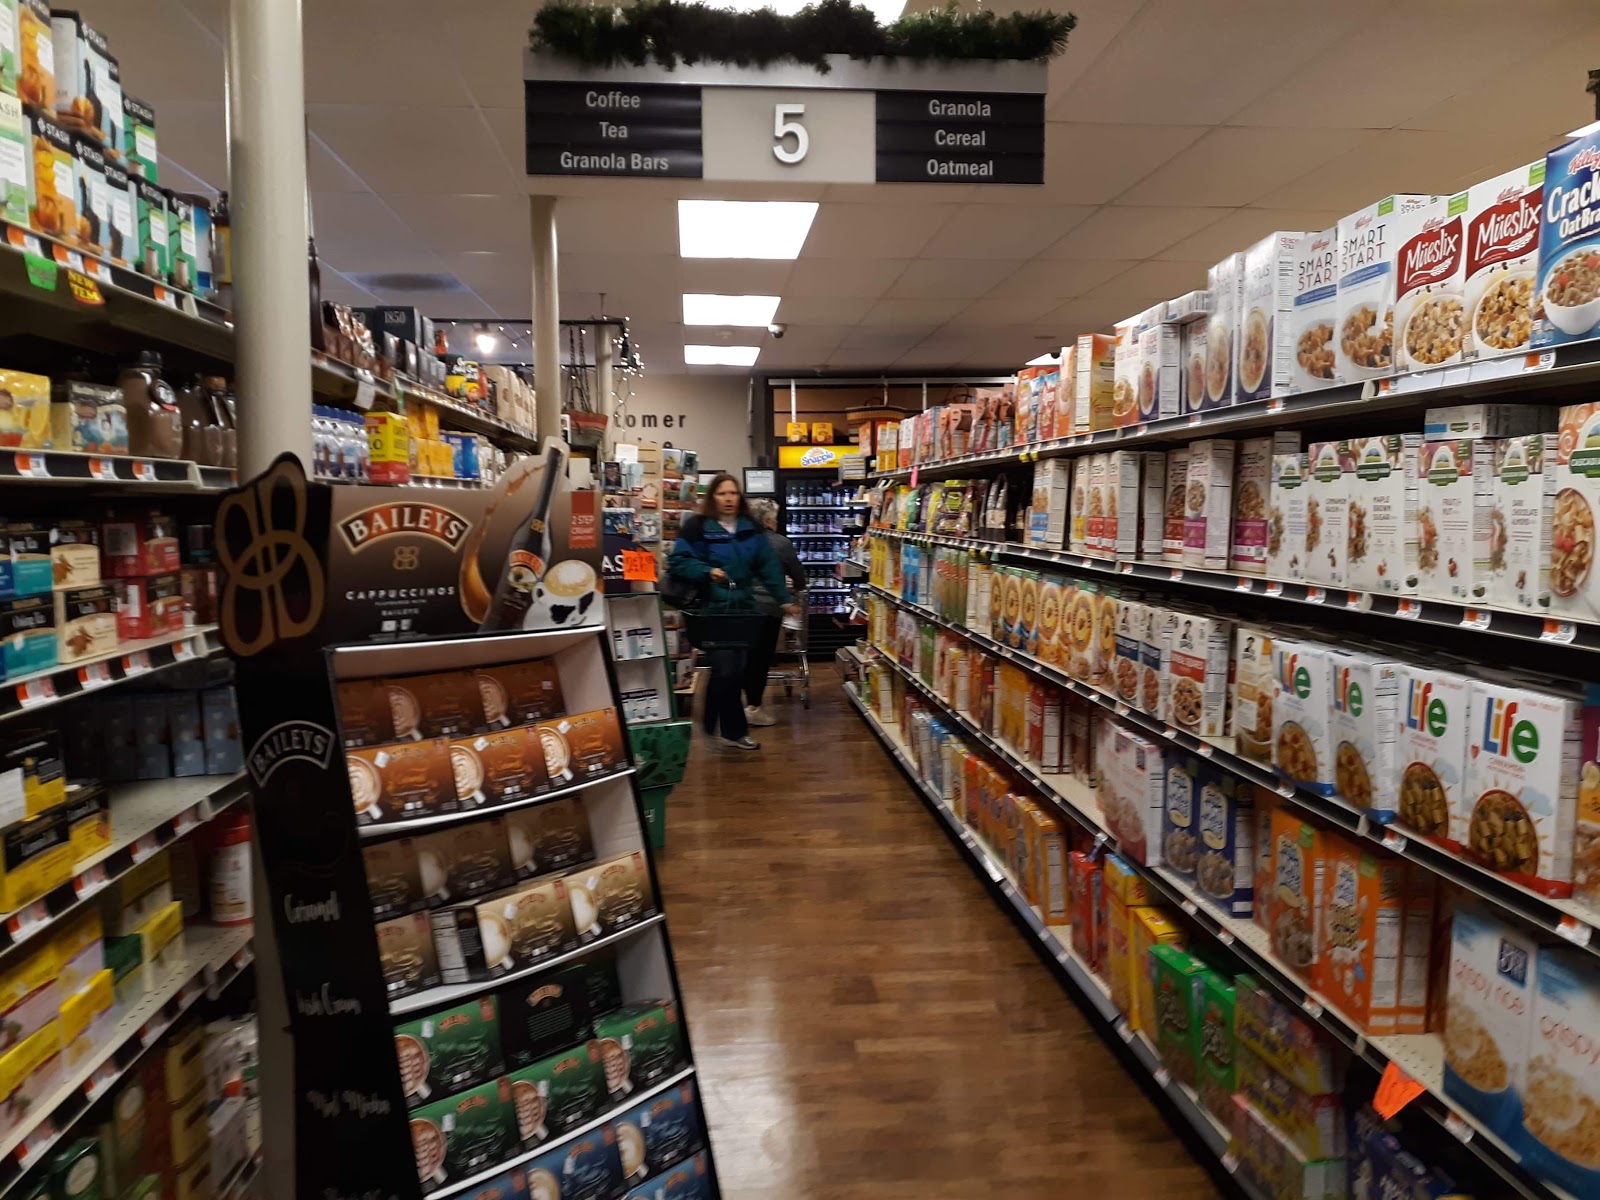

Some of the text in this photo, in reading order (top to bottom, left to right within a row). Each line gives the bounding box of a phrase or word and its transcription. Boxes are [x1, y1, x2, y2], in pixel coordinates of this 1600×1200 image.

[585, 90, 641, 108] Coffee
[928, 99, 991, 117] Granola
[45, 123, 71, 145] STASH
[599, 121, 629, 138] Tea
[772, 103, 809, 164] 5
[934, 129, 986, 146] Cereal
[560, 151, 670, 170] Granola Bars
[926, 159, 994, 176] Oatmeal
[1342, 224, 1387, 257] SMART
[1474, 198, 1544, 261] Müeslix
[1341, 241, 1386, 273] START
[1403, 228, 1460, 284] Müeslix
[802, 450, 834, 467] Snapple
[347, 506, 466, 543] BAILEYS
[345, 586, 456, 600] CAPPUCCINOS
[1279, 651, 1312, 700] Life
[1333, 665, 1364, 718] Life
[1406, 678, 1448, 738] Life
[1482, 697, 1540, 764] Life
[252, 729, 329, 774] BAILEYS
